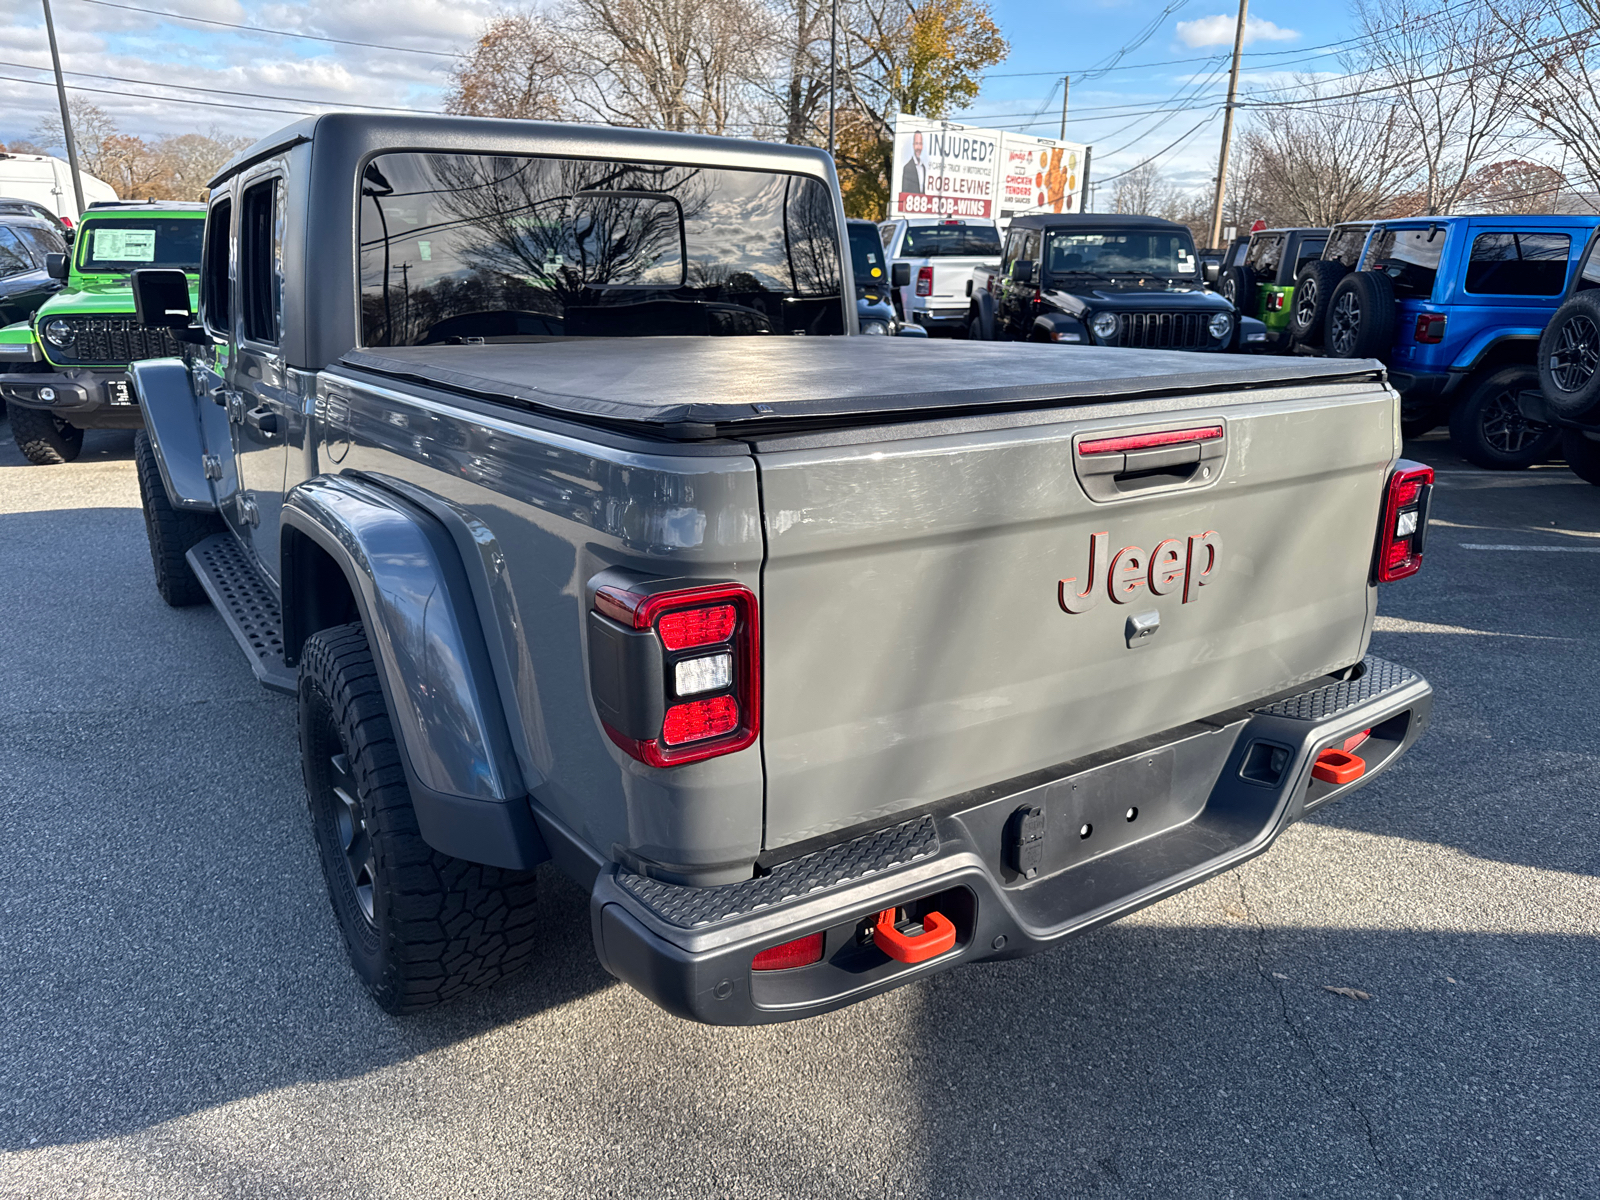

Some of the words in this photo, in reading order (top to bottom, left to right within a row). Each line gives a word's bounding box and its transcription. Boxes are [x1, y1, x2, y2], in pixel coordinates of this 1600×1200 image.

[929, 133, 994, 163] INJURED?
[928, 175, 950, 192] ROB
[953, 178, 990, 195] LEVINE
[1006, 175, 1032, 185] CHICKEN
[1005, 186, 1031, 196] TENDERS
[906, 195, 984, 215] 888-ROB-WINS
[1058, 531, 1223, 614] Jeep
